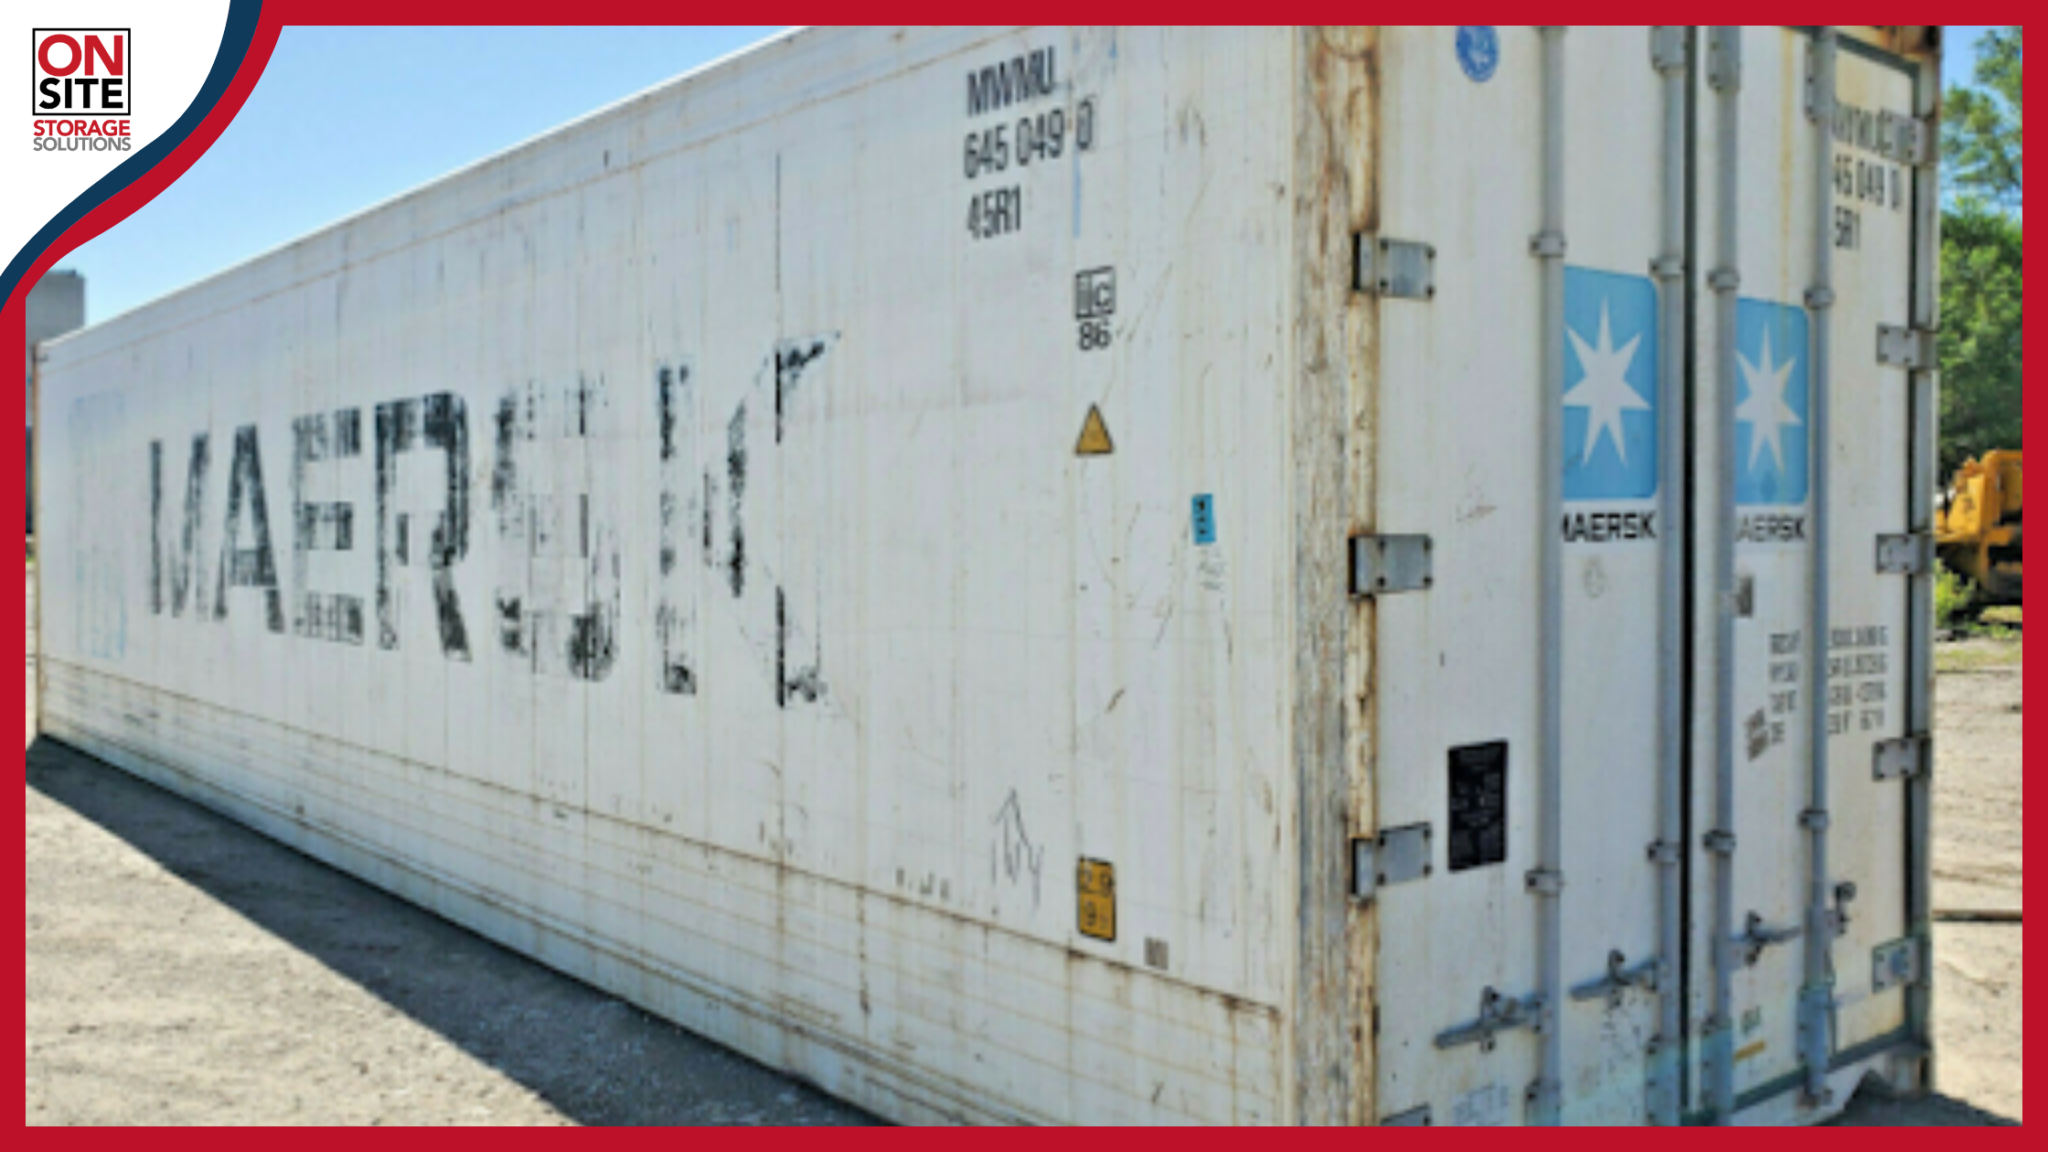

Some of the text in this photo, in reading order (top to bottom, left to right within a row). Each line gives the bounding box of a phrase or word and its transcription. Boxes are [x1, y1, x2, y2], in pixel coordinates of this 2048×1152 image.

[963, 123, 1009, 179] 645
[1016, 108, 1065, 166] 049
[1833, 152, 1853, 198] 45
[966, 184, 1022, 240] 45R1
[1080, 320, 1112, 350] 86
[1735, 513, 1806, 542] AERSK
